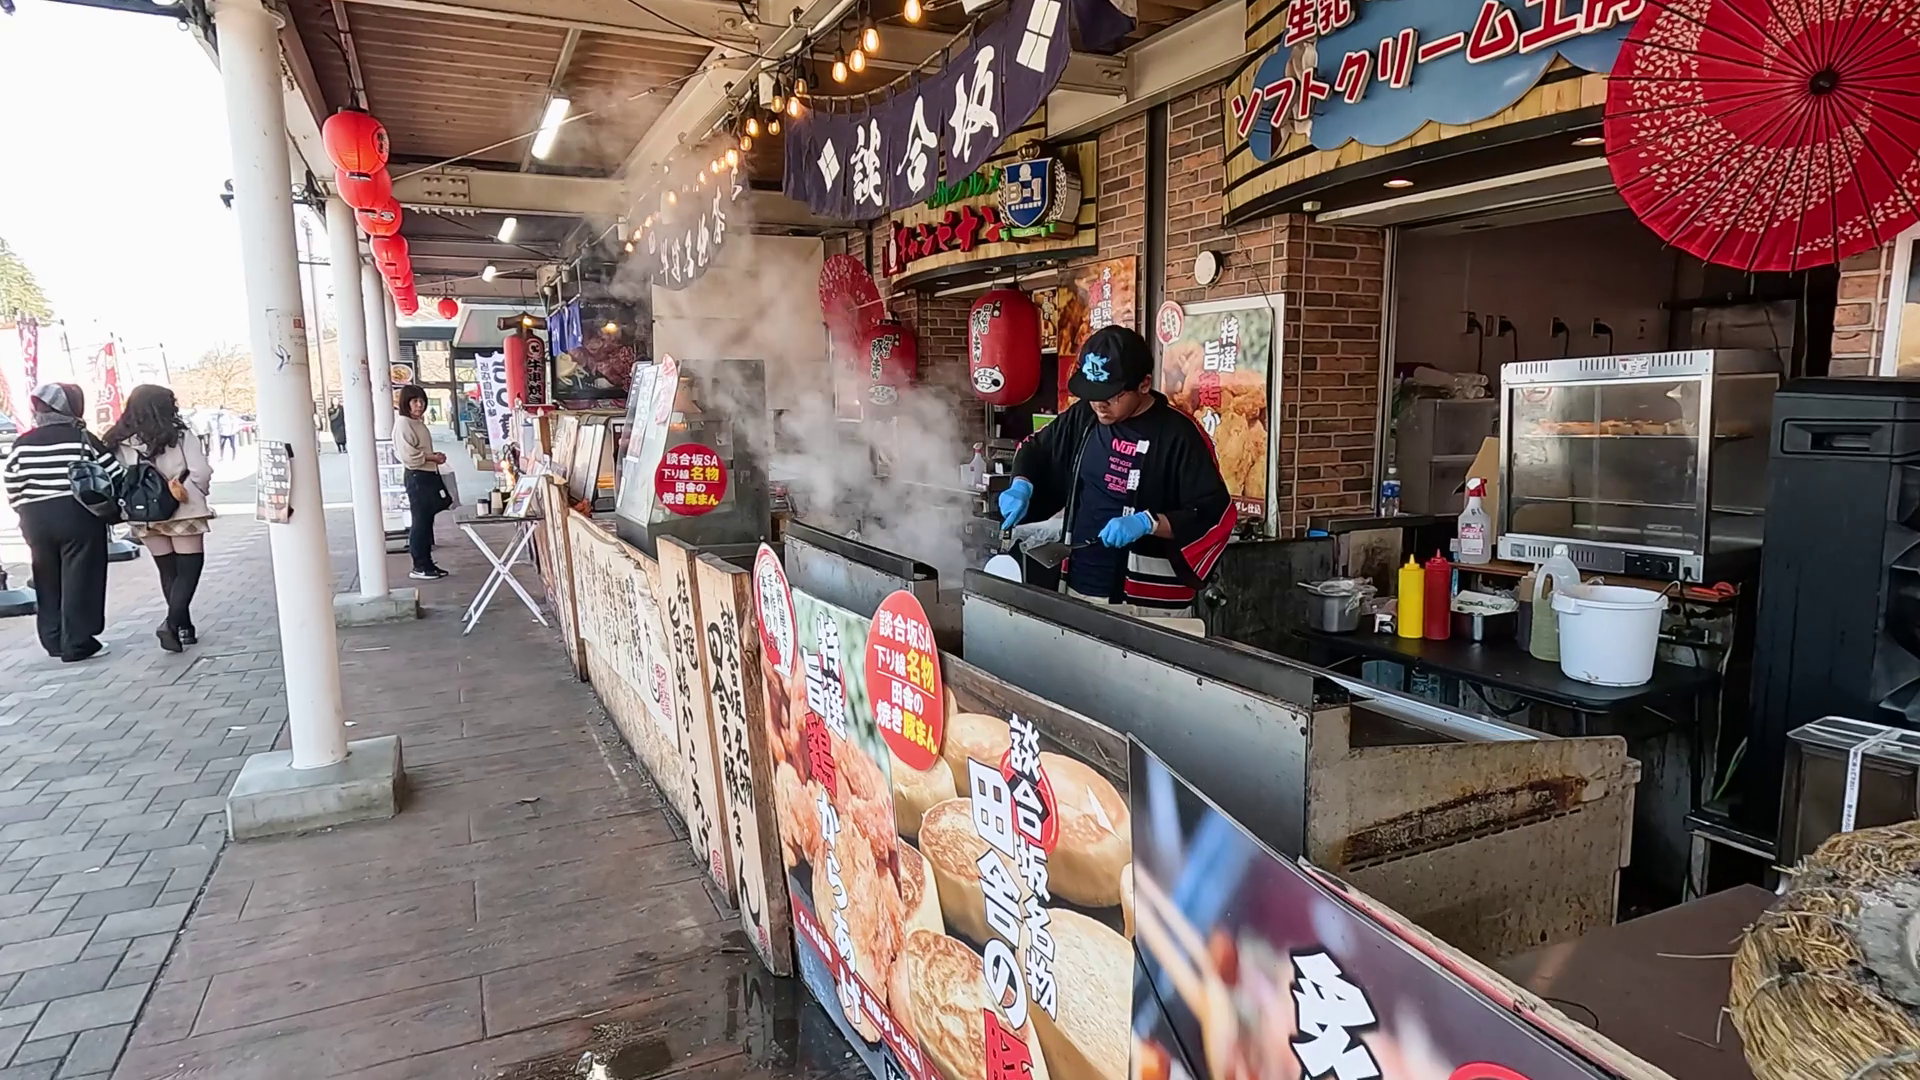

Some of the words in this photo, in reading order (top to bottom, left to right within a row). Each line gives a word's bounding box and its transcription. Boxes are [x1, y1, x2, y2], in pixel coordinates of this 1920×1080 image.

[849, 45, 999, 207] 談合坂
[1218, 316, 1240, 374] 特選
[1199, 340, 1222, 440] 旨鶏か
[666, 452, 719, 467] 談合坂SA
[675, 481, 707, 493] 田舎の
[662, 492, 719, 506] 焼き豚まん
[878, 608, 933, 655] 談合坂SA
[816, 611, 848, 742] 特選
[890, 679, 924, 716] 田舎の
[719, 599, 755, 814] 談合坂名物
[876, 699, 938, 756] 焼き豚まん
[1008, 712, 1058, 1023] 談合坂名物
